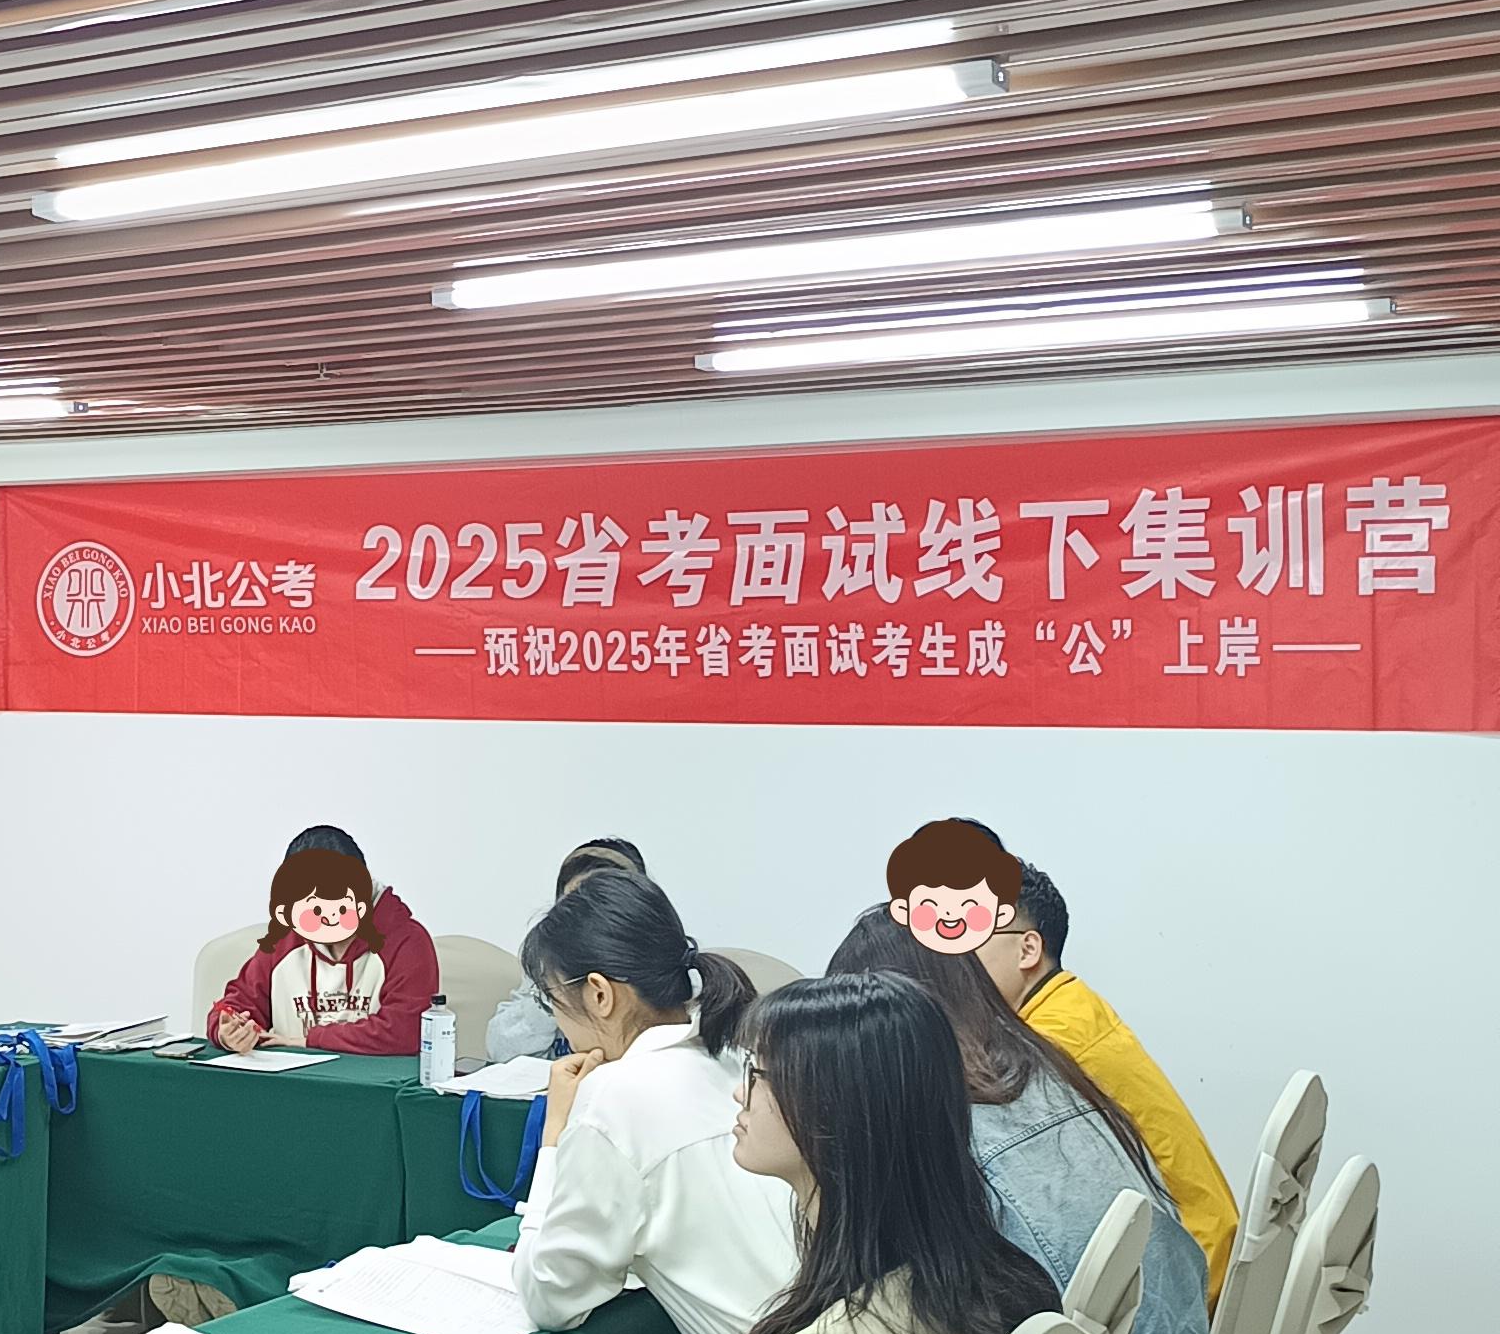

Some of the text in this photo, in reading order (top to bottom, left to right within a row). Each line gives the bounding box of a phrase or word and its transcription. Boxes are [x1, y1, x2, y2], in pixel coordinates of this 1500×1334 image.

[60, 550, 80, 569] BEI
[82, 548, 115, 571] GONG
[355, 476, 1451, 608] 2025省考面试线下集训营
[141, 560, 317, 609] 小北公考
[141, 616, 316, 634] XIAO BEI GONG KAO
